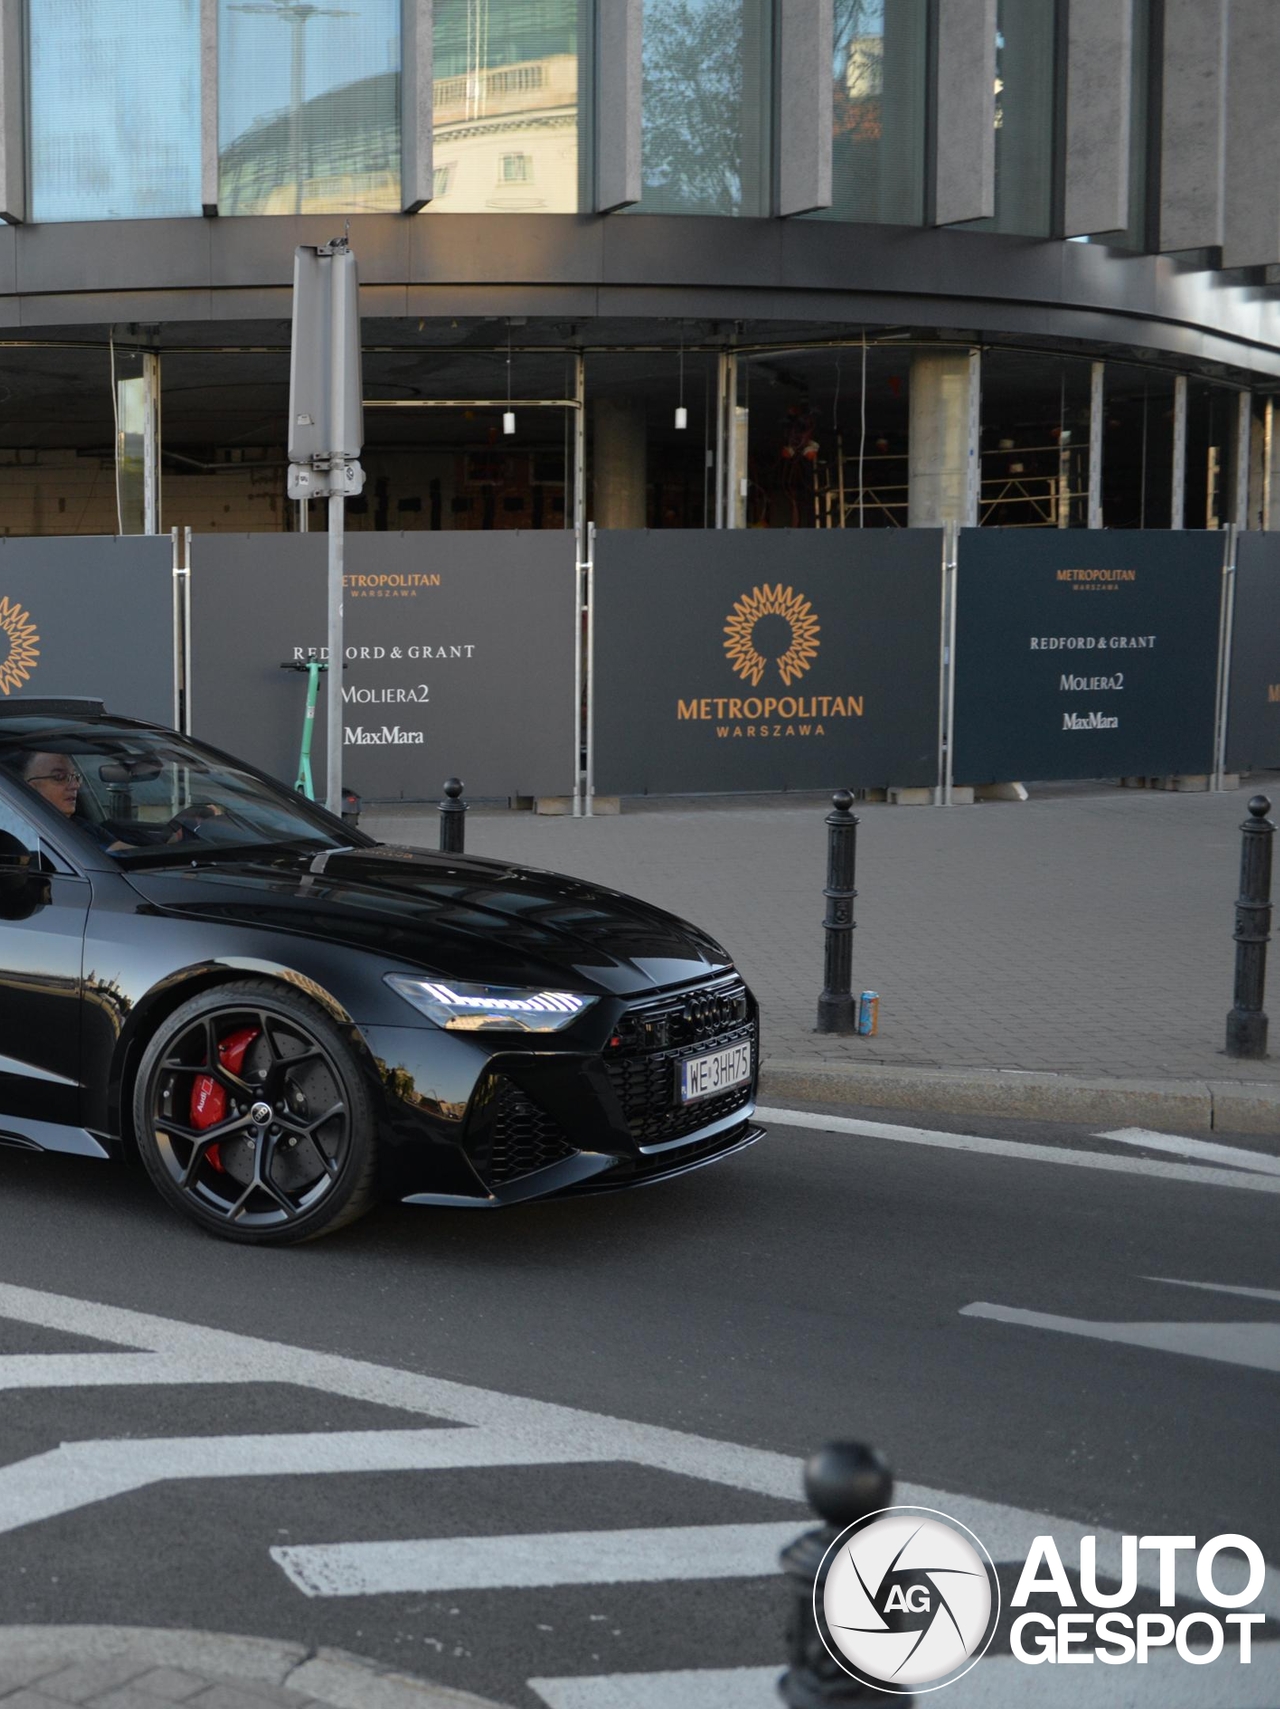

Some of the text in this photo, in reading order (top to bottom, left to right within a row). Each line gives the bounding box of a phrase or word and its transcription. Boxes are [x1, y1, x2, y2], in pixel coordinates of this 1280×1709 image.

[341, 574, 441, 587] ETROPOLITAN
[1056, 569, 1136, 581] METROPOLITAN
[1030, 636, 1156, 649] REDFORD & GRANT
[293, 645, 475, 659] REDORD & GRANT
[1059, 673, 1124, 690] MOLIERA2
[677, 696, 864, 720] METROPOLITAN
[1062, 712, 1118, 730] MaxMara
[344, 726, 424, 745] MaxMara
[716, 725, 825, 737] WARSZAWA
[690, 1046, 748, 1095] WE 3HH75
[197, 1091, 207, 1112] Audi
